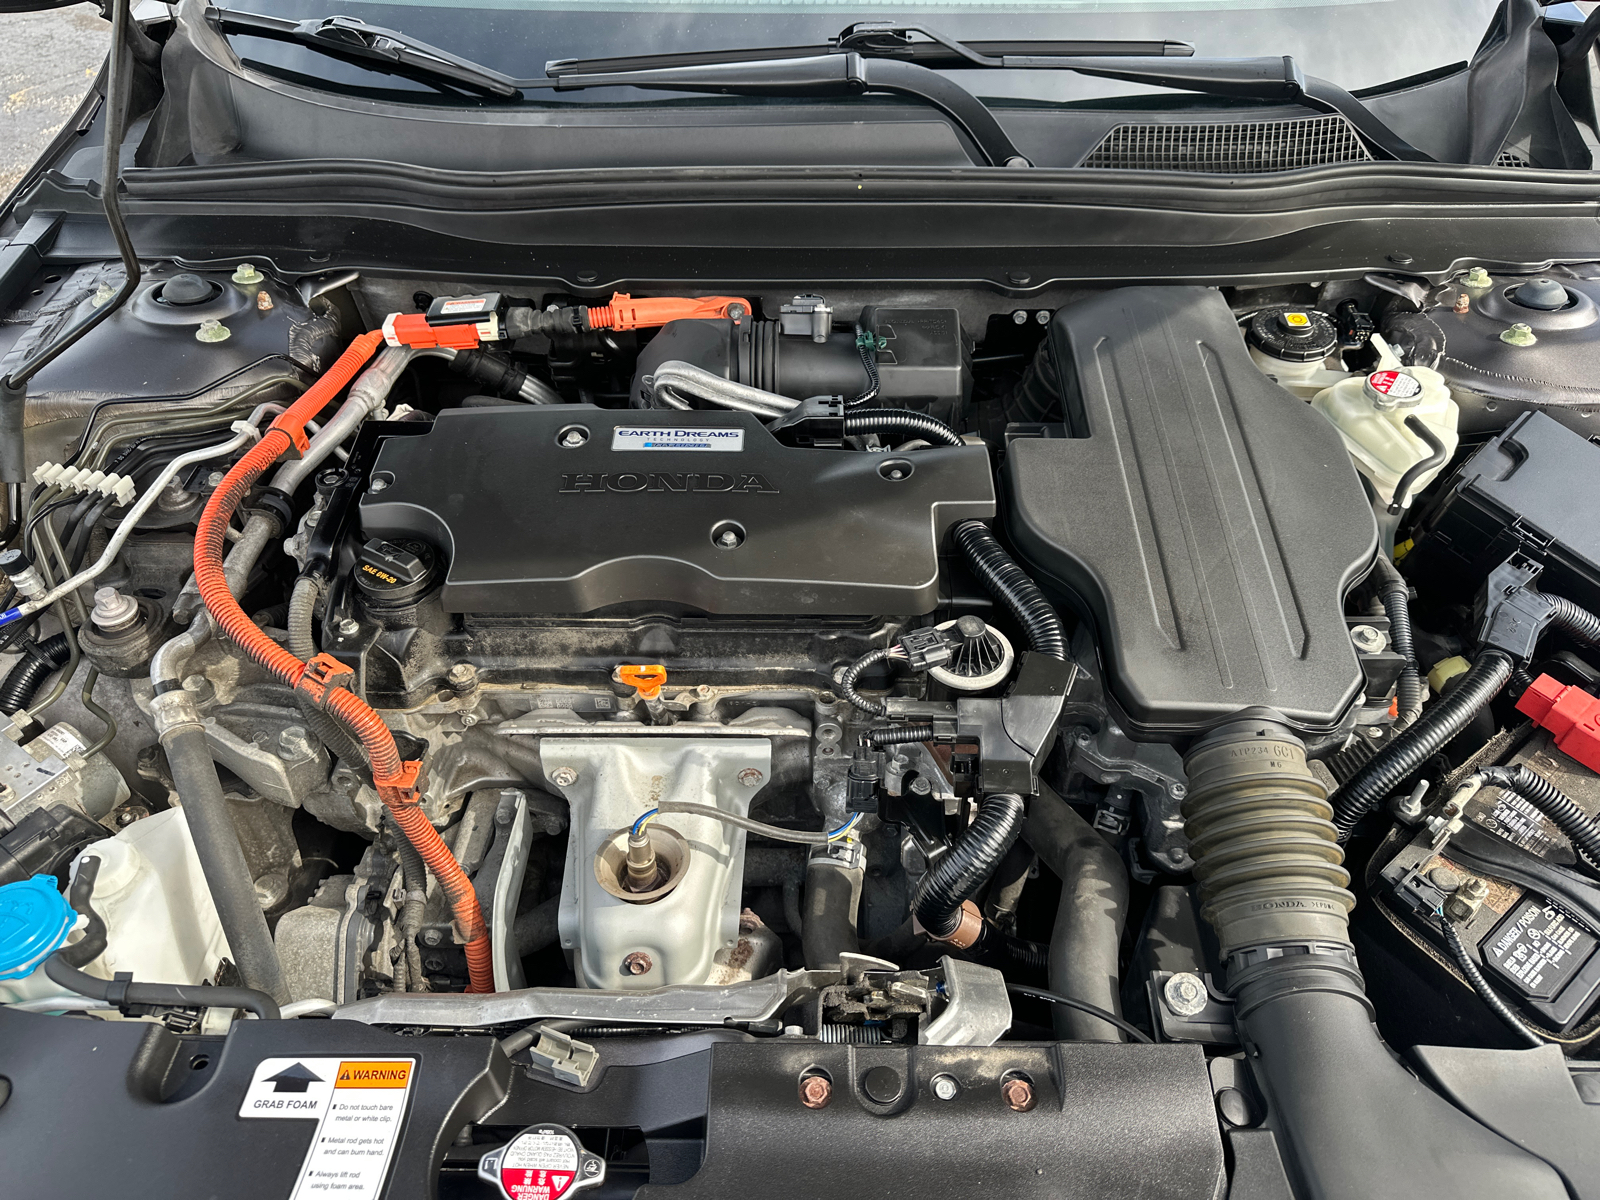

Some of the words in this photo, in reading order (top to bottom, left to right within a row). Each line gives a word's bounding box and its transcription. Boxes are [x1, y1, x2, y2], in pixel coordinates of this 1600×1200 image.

[559, 472, 779, 493] HONDA
[362, 565, 378, 575] SAE
[376, 572, 397, 584] 0W-20
[1251, 901, 1308, 911] HONDA
[353, 1070, 407, 1080] WARNING
[254, 1100, 284, 1109] GRAB
[286, 1100, 318, 1109] FOAM
